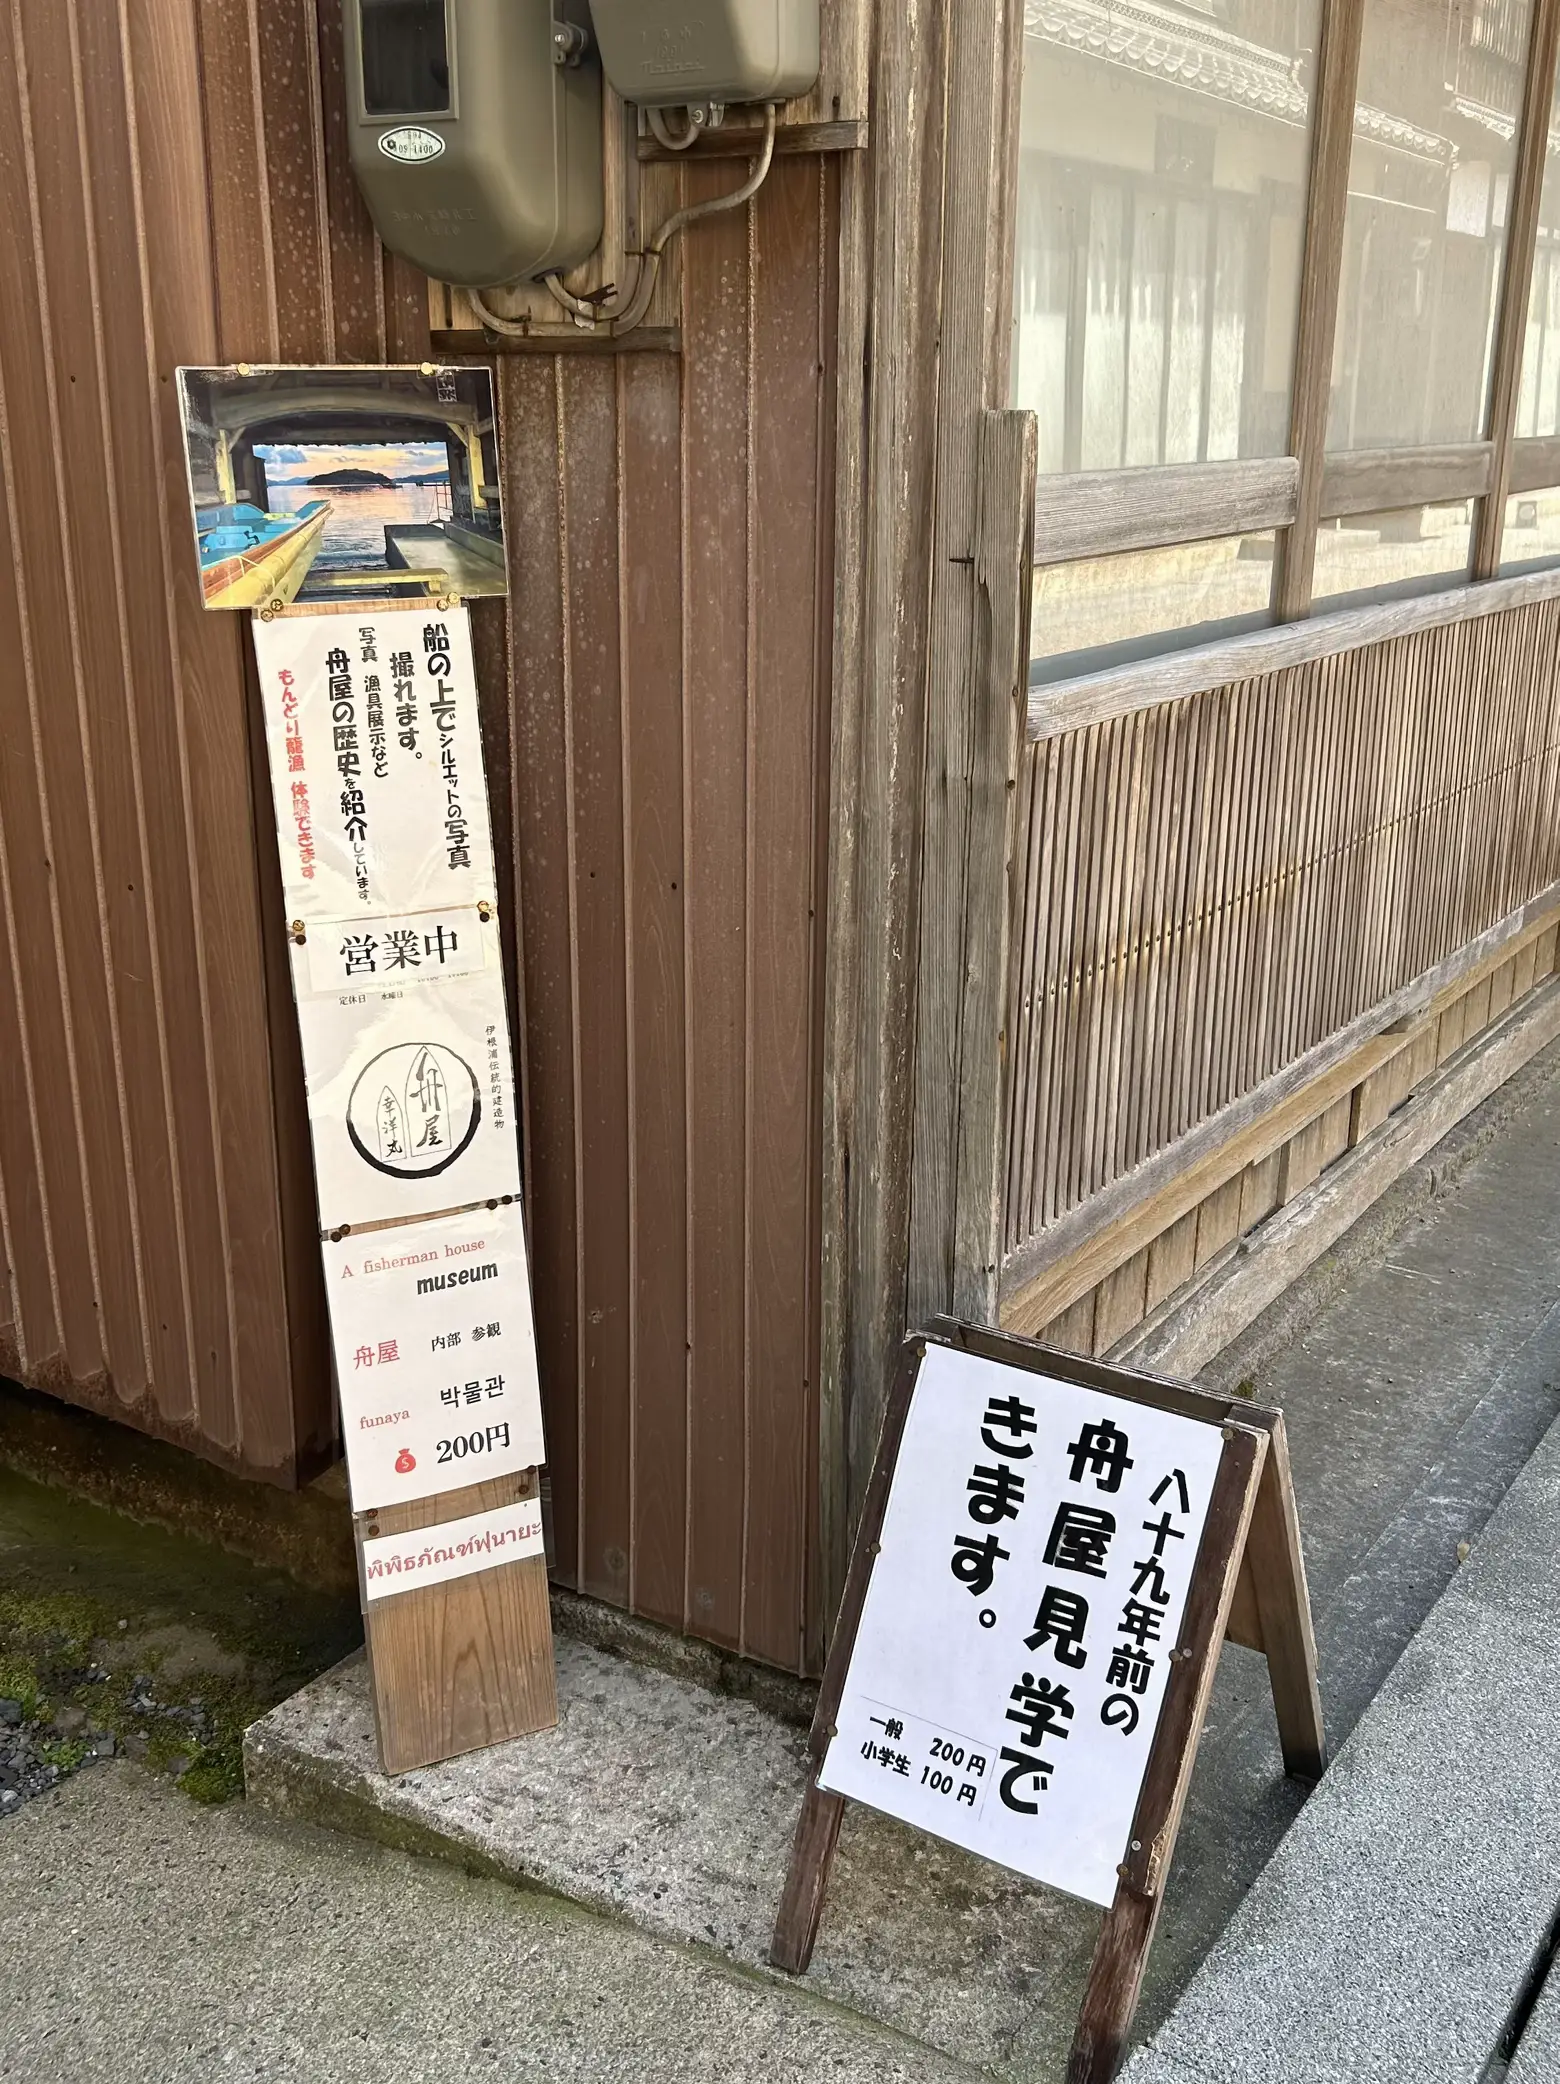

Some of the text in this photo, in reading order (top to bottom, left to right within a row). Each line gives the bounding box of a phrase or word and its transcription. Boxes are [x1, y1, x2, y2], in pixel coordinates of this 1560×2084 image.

[358, 627, 388, 778] 写真 漁具展示など
[390, 651, 423, 759] 撮れます。
[423, 623, 472, 870] 船の上でシルエットの写真
[325, 648, 371, 905] 舟屋の歴史を紹介しています。
[339, 925, 458, 976] 営業中
[341, 1239, 486, 1279] A fisherman house
[416, 1262, 499, 1295] museum
[353, 1339, 400, 1370] 舟屋
[440, 1374, 506, 1409] 박물관
[359, 1408, 411, 1429] funaya
[436, 1422, 511, 1464] 200円
[950, 1395, 1037, 1630] きます。
[1100, 1468, 1191, 1737] 八十九年前の
[869, 1716, 903, 1740] 一般
[860, 1740, 911, 1777] 小学生
